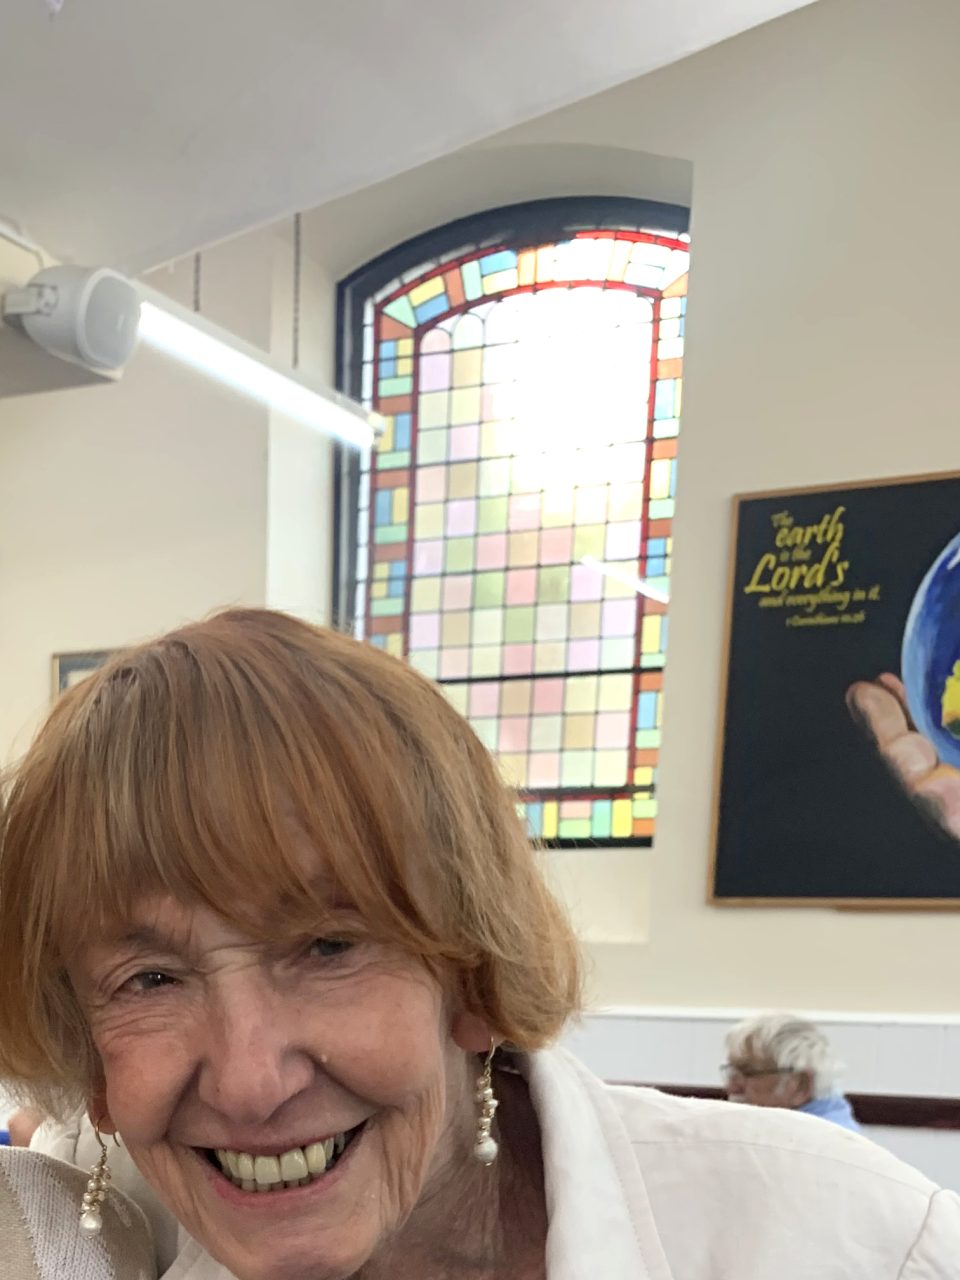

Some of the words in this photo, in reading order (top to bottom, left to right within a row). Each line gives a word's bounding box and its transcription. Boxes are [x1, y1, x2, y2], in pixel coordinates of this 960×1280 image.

[775, 506, 846, 547] earth
[744, 542, 849, 594] Lord's
[758, 589, 787, 608] and
[785, 587, 850, 613] everything
[852, 589, 866, 601] in
